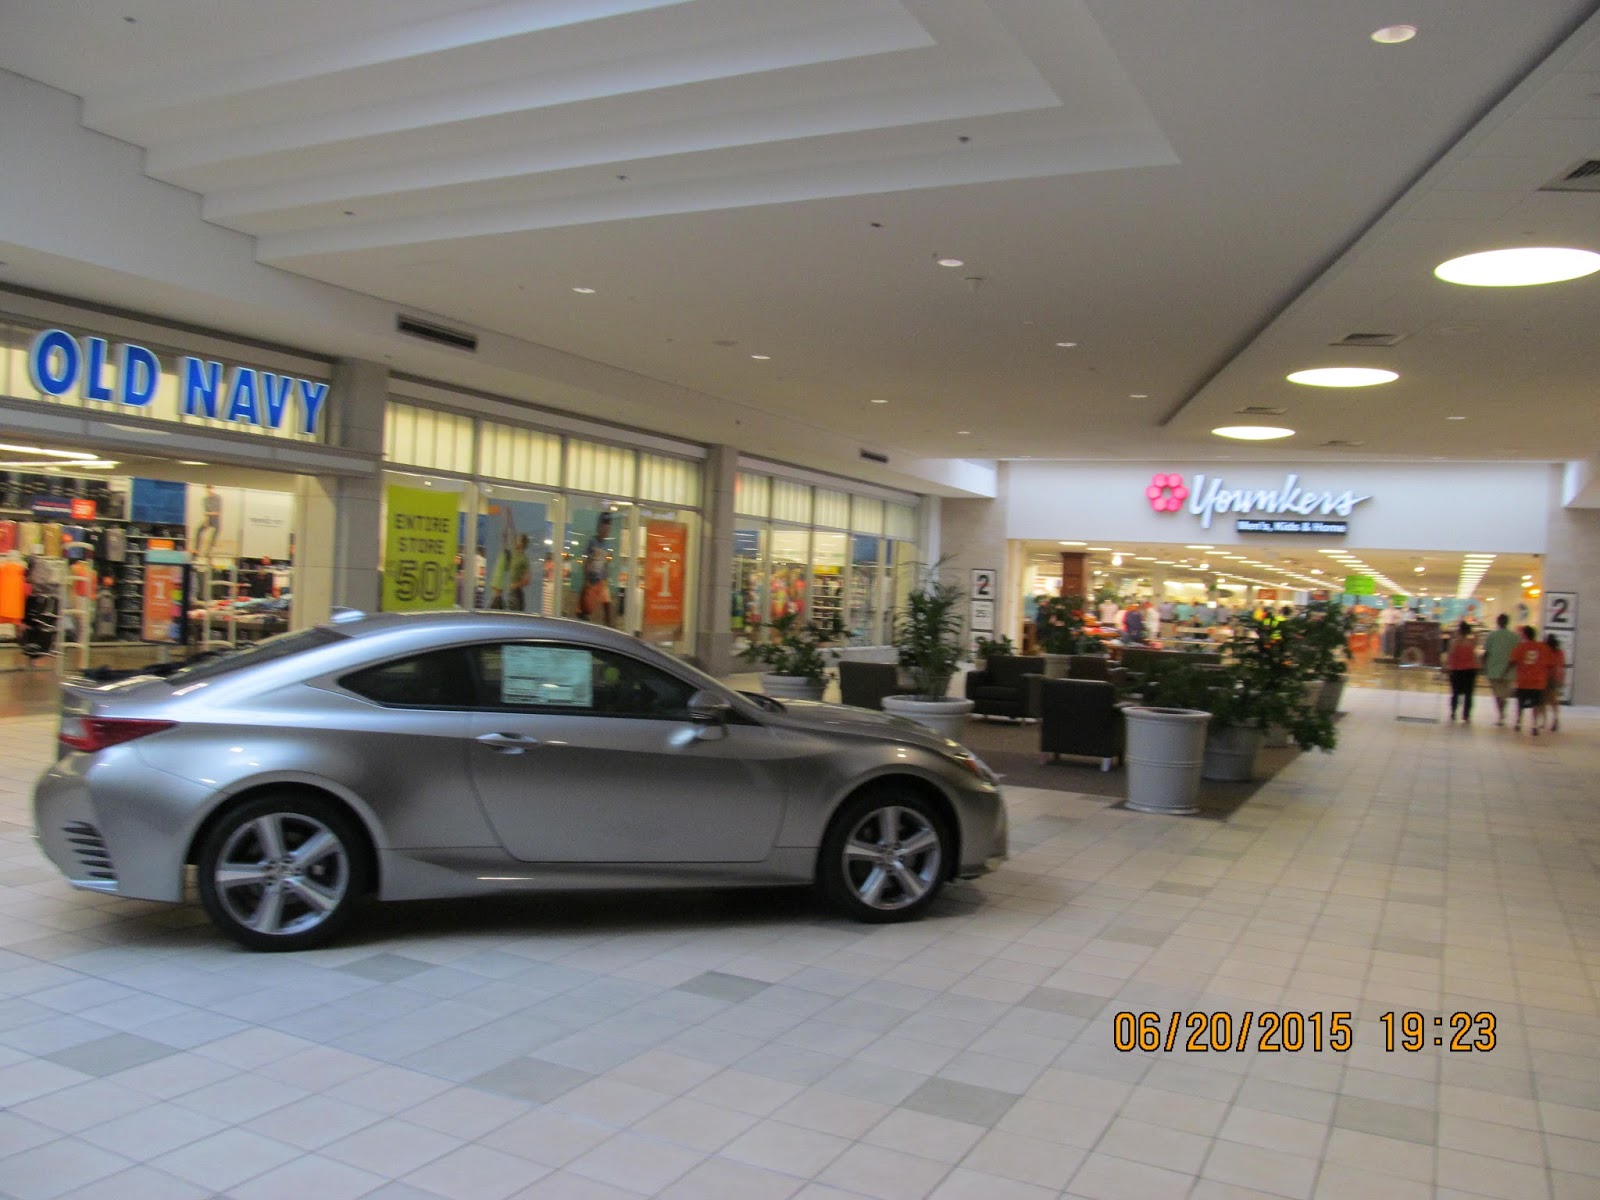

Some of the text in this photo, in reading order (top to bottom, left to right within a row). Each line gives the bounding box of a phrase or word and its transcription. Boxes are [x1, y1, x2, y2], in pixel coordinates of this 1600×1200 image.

[30, 328, 329, 434] OLD NAVY
[1188, 473, 1373, 529] Younkers
[395, 513, 450, 533] ENTIRE
[399, 537, 445, 555] STORE
[977, 574, 990, 596] 2
[1552, 598, 1568, 623] 2
